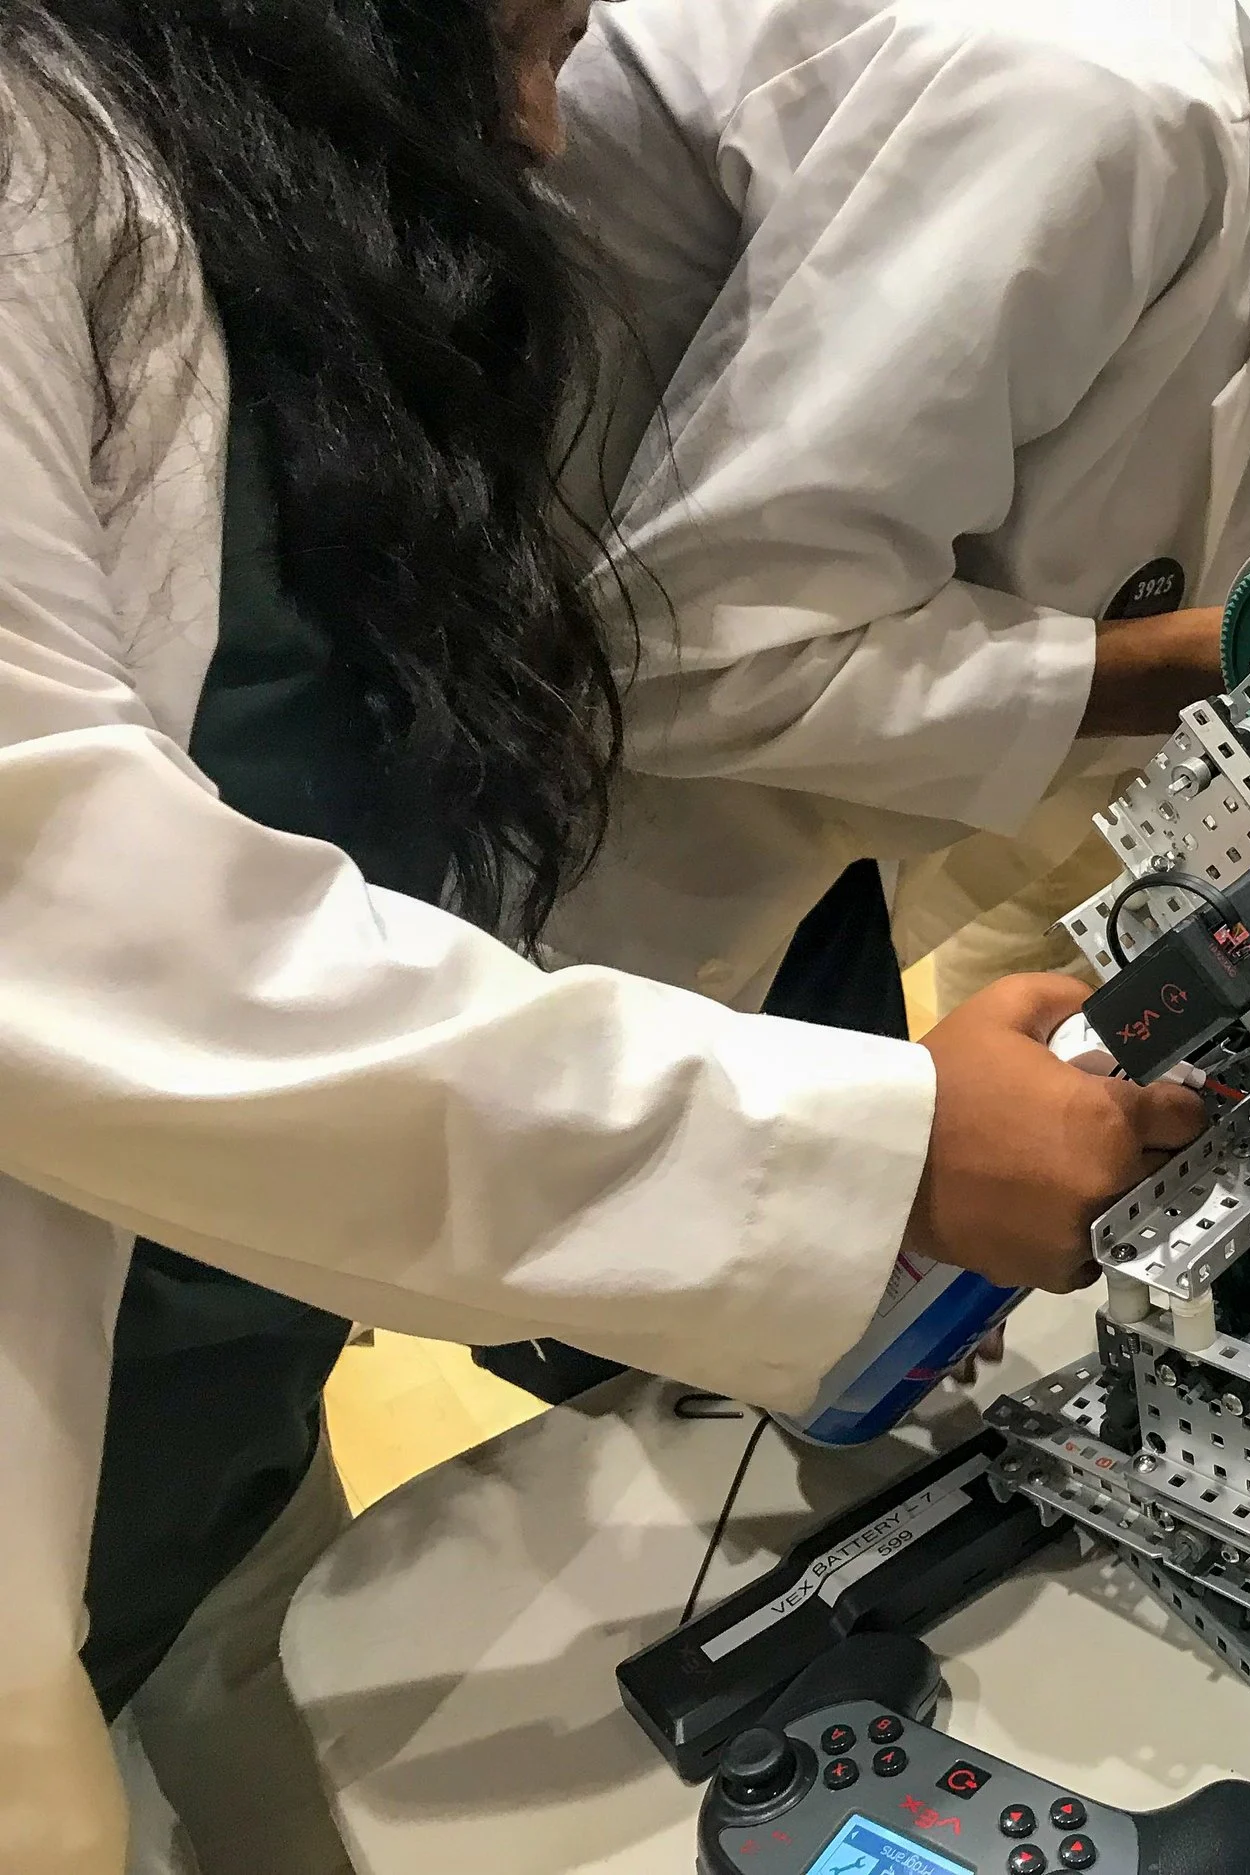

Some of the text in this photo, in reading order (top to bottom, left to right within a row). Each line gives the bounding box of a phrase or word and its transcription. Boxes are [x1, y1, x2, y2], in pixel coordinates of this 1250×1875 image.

[1134, 574, 1174, 600] 3925
[1116, 1009, 1161, 1045] VEX
[771, 1579, 814, 1615] VEX
[812, 1512, 901, 1577] BATTERY
[920, 1492, 932, 1503] 7
[878, 1530, 913, 1557] 599
[898, 1794, 961, 1836] VEX
